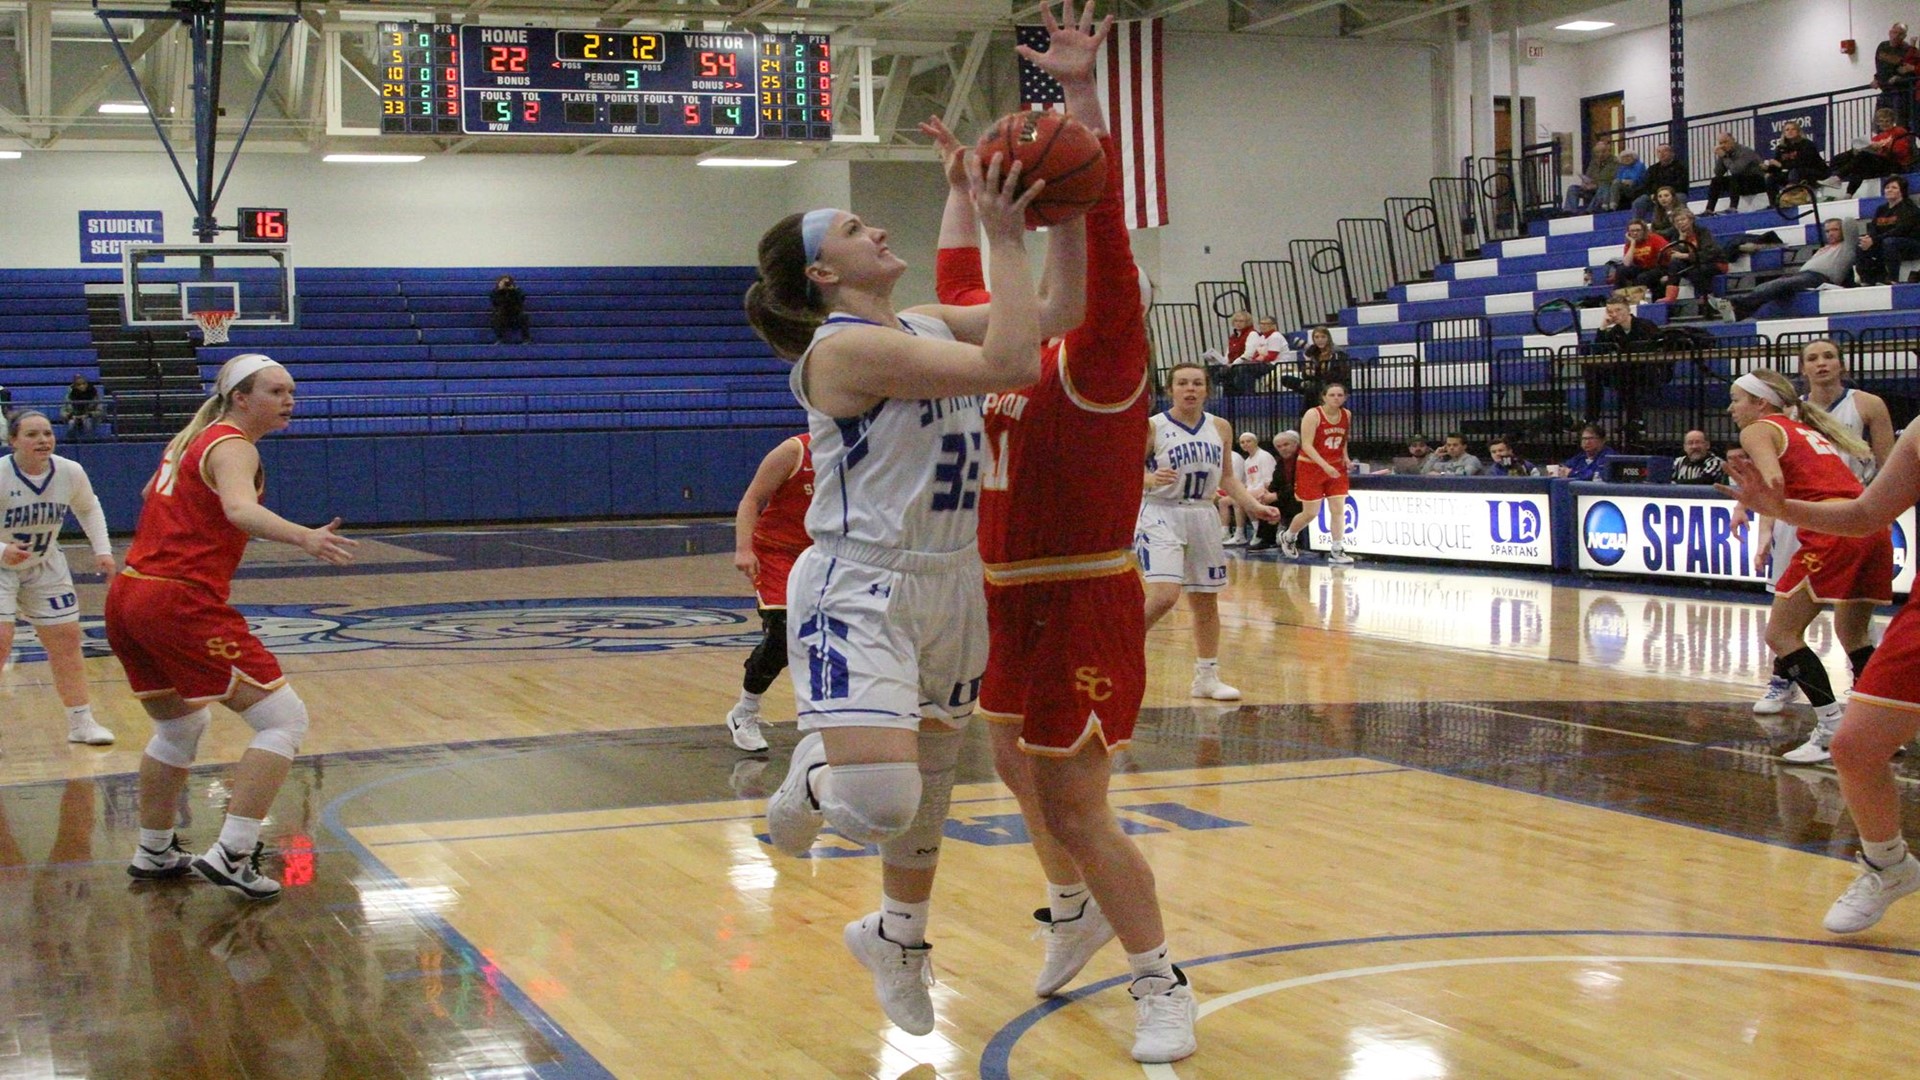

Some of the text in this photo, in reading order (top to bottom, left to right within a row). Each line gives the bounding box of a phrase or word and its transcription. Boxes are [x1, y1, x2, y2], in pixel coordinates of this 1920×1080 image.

[384, 24, 398, 32] NO
[434, 25, 452, 33] PTS
[392, 33, 402, 46] 3
[419, 34, 429, 47] 0
[482, 30, 528, 44] HOME
[684, 36, 744, 48] VISITOR
[584, 34, 656, 60] 2:12
[763, 44, 780, 56] 11
[795, 45, 804, 57] 2
[819, 45, 828, 57] 7
[1529, 46, 1544, 56] EXIT
[392, 50, 402, 64] 5
[490, 46, 528, 72] 22
[562, 62, 582, 70] POSS
[642, 64, 662, 72] POSS
[700, 52, 736, 77] 54
[761, 60, 780, 72] 24
[796, 61, 804, 73] 0
[819, 61, 828, 73] 8
[388, 67, 404, 80] 10
[420, 68, 430, 81] 0
[446, 68, 456, 81] 0
[584, 72, 620, 82] PERIOD
[625, 70, 639, 89] 3
[497, 76, 530, 86] BONUS
[692, 81, 724, 90] BONUS
[761, 76, 780, 88] 25
[796, 77, 804, 89] 0
[820, 77, 829, 89] 0
[384, 84, 404, 97] 24
[420, 84, 430, 98] 2
[448, 84, 457, 98] 3
[480, 92, 511, 100] FOULS
[522, 92, 540, 101] TOL
[562, 93, 674, 104] PLAYER POINTS FOULS
[682, 96, 700, 104] TOL
[712, 96, 741, 105] FOULS
[762, 92, 782, 104] 31
[796, 93, 806, 105] 0
[821, 93, 830, 105] 3
[384, 101, 404, 114] 33
[422, 102, 431, 115] 3
[448, 102, 457, 115] 3
[496, 102, 511, 122] 5
[524, 102, 539, 122] 2
[684, 106, 699, 124] 5
[726, 106, 741, 125] 4
[762, 108, 782, 120] 41
[820, 109, 830, 121] 4
[489, 123, 510, 132] WON
[612, 125, 636, 134] GAME
[715, 126, 735, 135] WON
[1771, 116, 1812, 133] VIOR
[88, 219, 154, 234] STUDENT
[256, 212, 284, 238] 16
[1168, 442, 1222, 471] SPARTANS
[4, 502, 67, 529] SPARTANS
[1319, 535, 1358, 546] SPAANS
[1371, 520, 1472, 554] DUBUQUE
[1588, 532, 1628, 550] NCAA
[1491, 544, 1538, 558] SPARTANS
[206, 636, 242, 660] SC
[1075, 666, 1112, 701] SC
